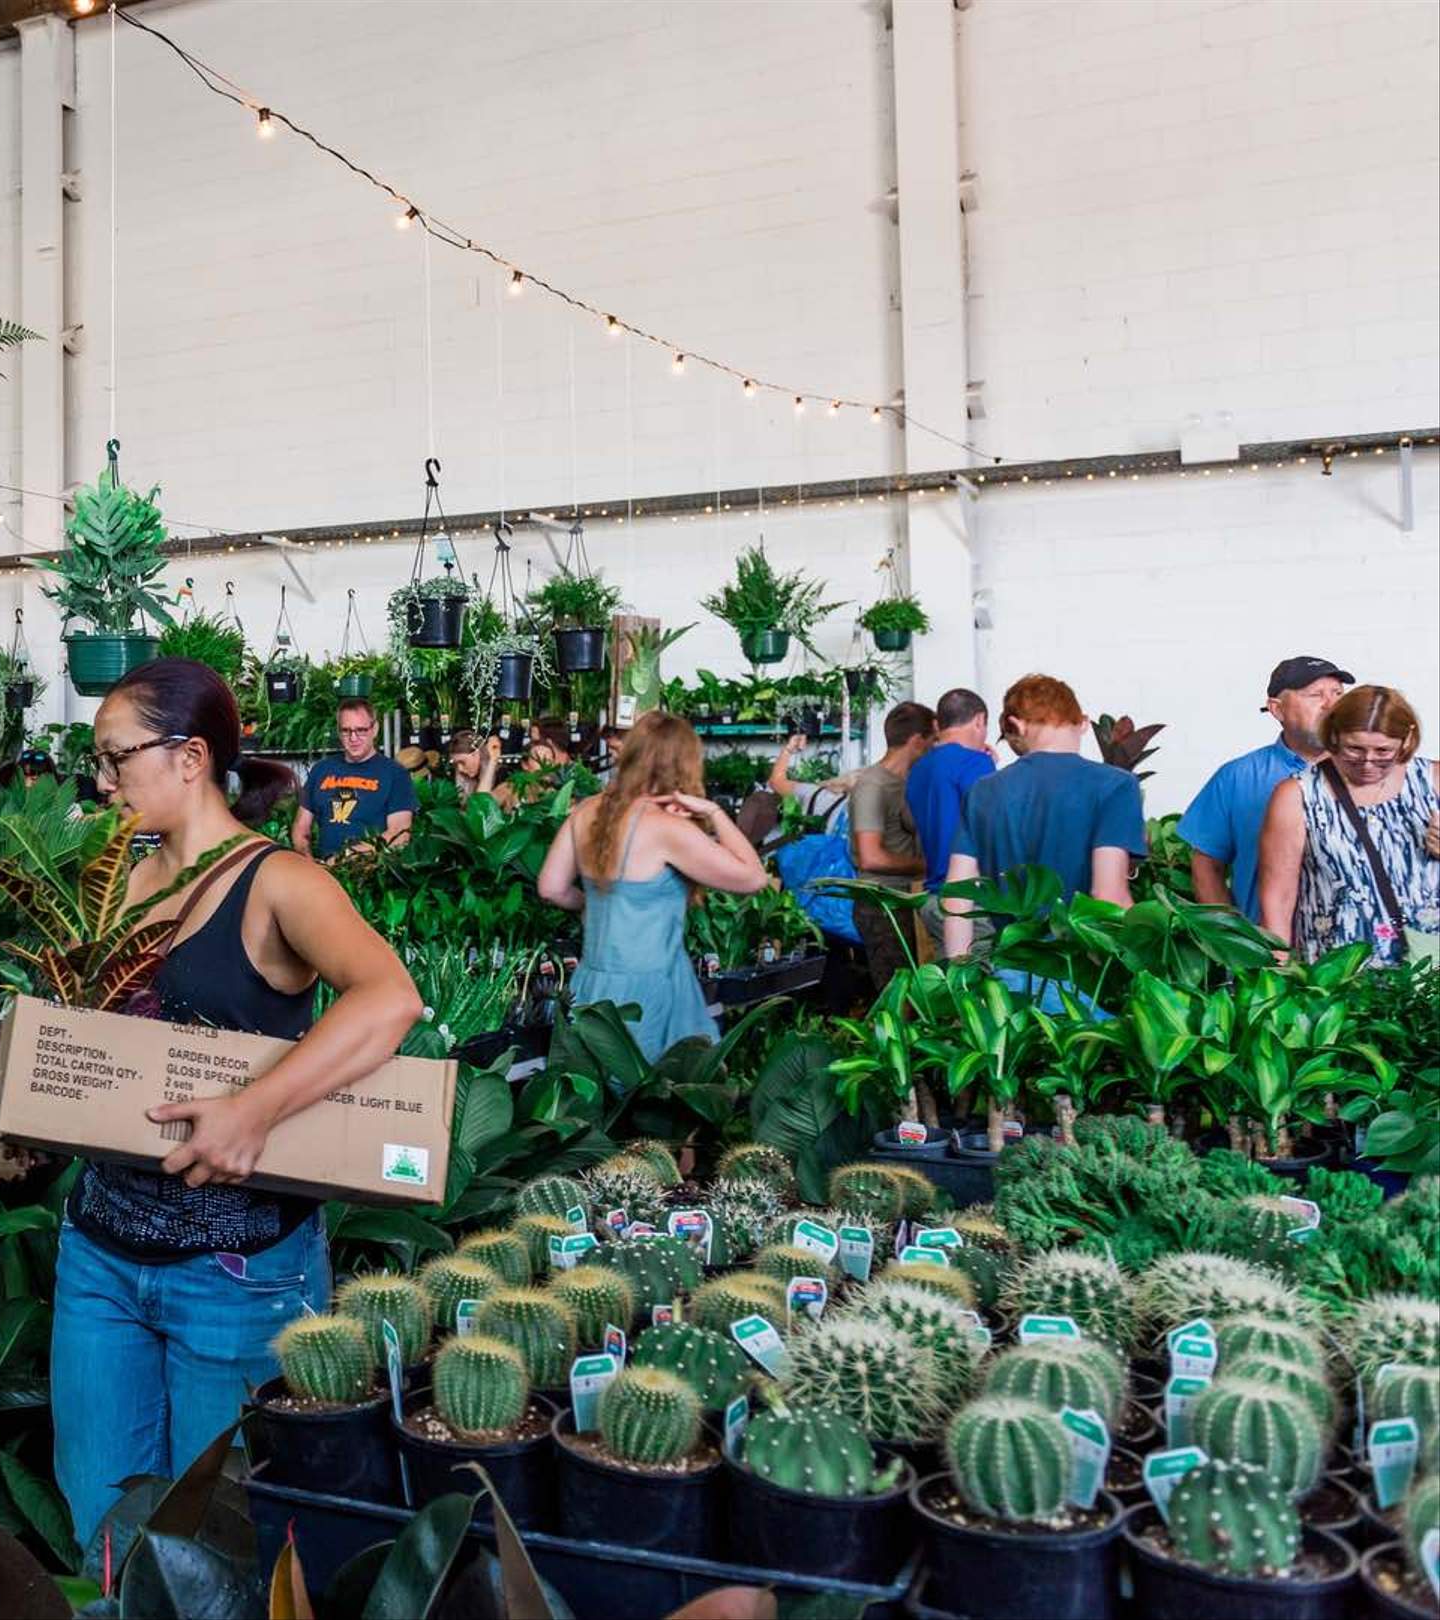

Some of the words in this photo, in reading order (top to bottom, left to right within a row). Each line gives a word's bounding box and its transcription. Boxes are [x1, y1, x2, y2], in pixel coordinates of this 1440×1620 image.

[35, 1053, 68, 1068] TOTAL
[71, 1060, 114, 1076] CARTON
[168, 1048, 211, 1065] GARDEN
[213, 1056, 250, 1072] DECOR
[33, 1067, 70, 1084] GROSS
[165, 1076, 172, 1087] 2
[166, 1063, 202, 1079] GLOSS
[360, 1096, 392, 1111] LIGHT
[395, 1100, 423, 1114] BLUE
